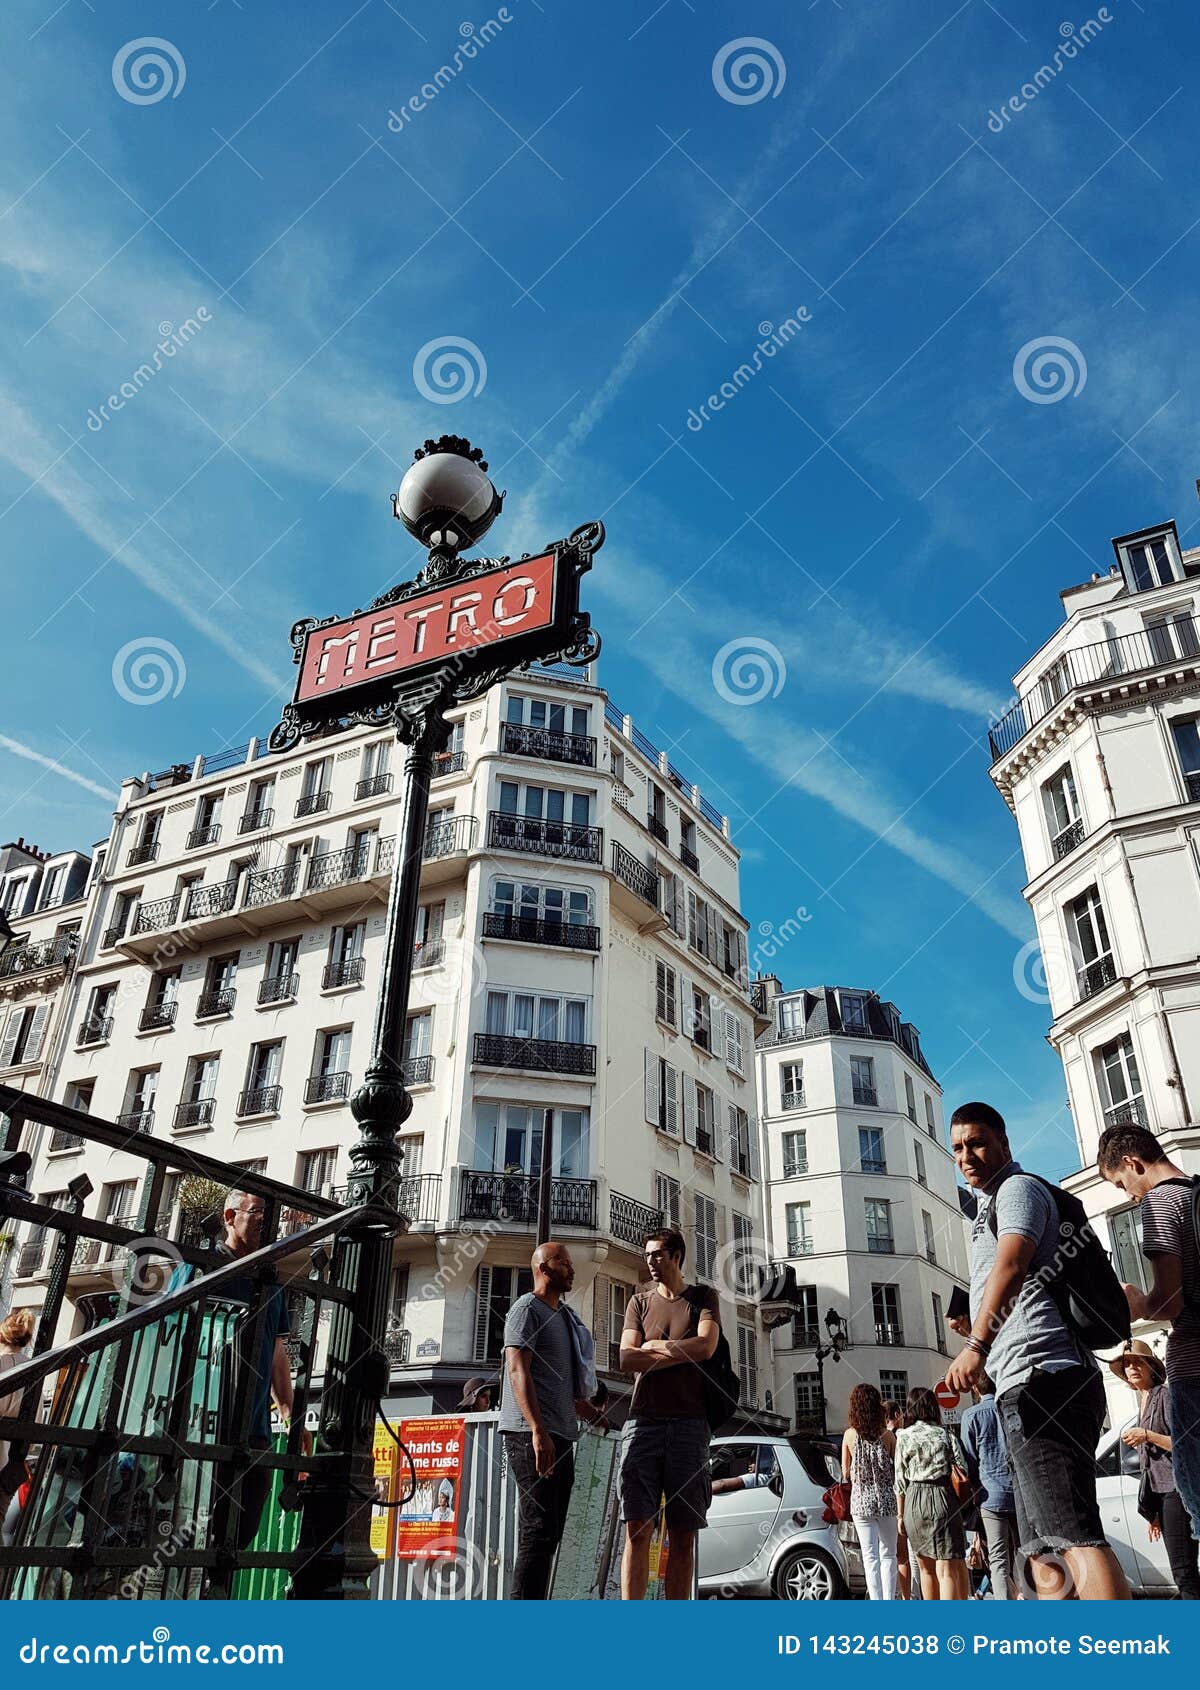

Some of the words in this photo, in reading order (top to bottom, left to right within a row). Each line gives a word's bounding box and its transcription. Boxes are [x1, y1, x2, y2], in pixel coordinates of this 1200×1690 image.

[315, 575, 538, 686] METRO
[445, 1439, 460, 1453] de
[375, 1446, 393, 1461] tti
[431, 1457, 460, 1468] russe
